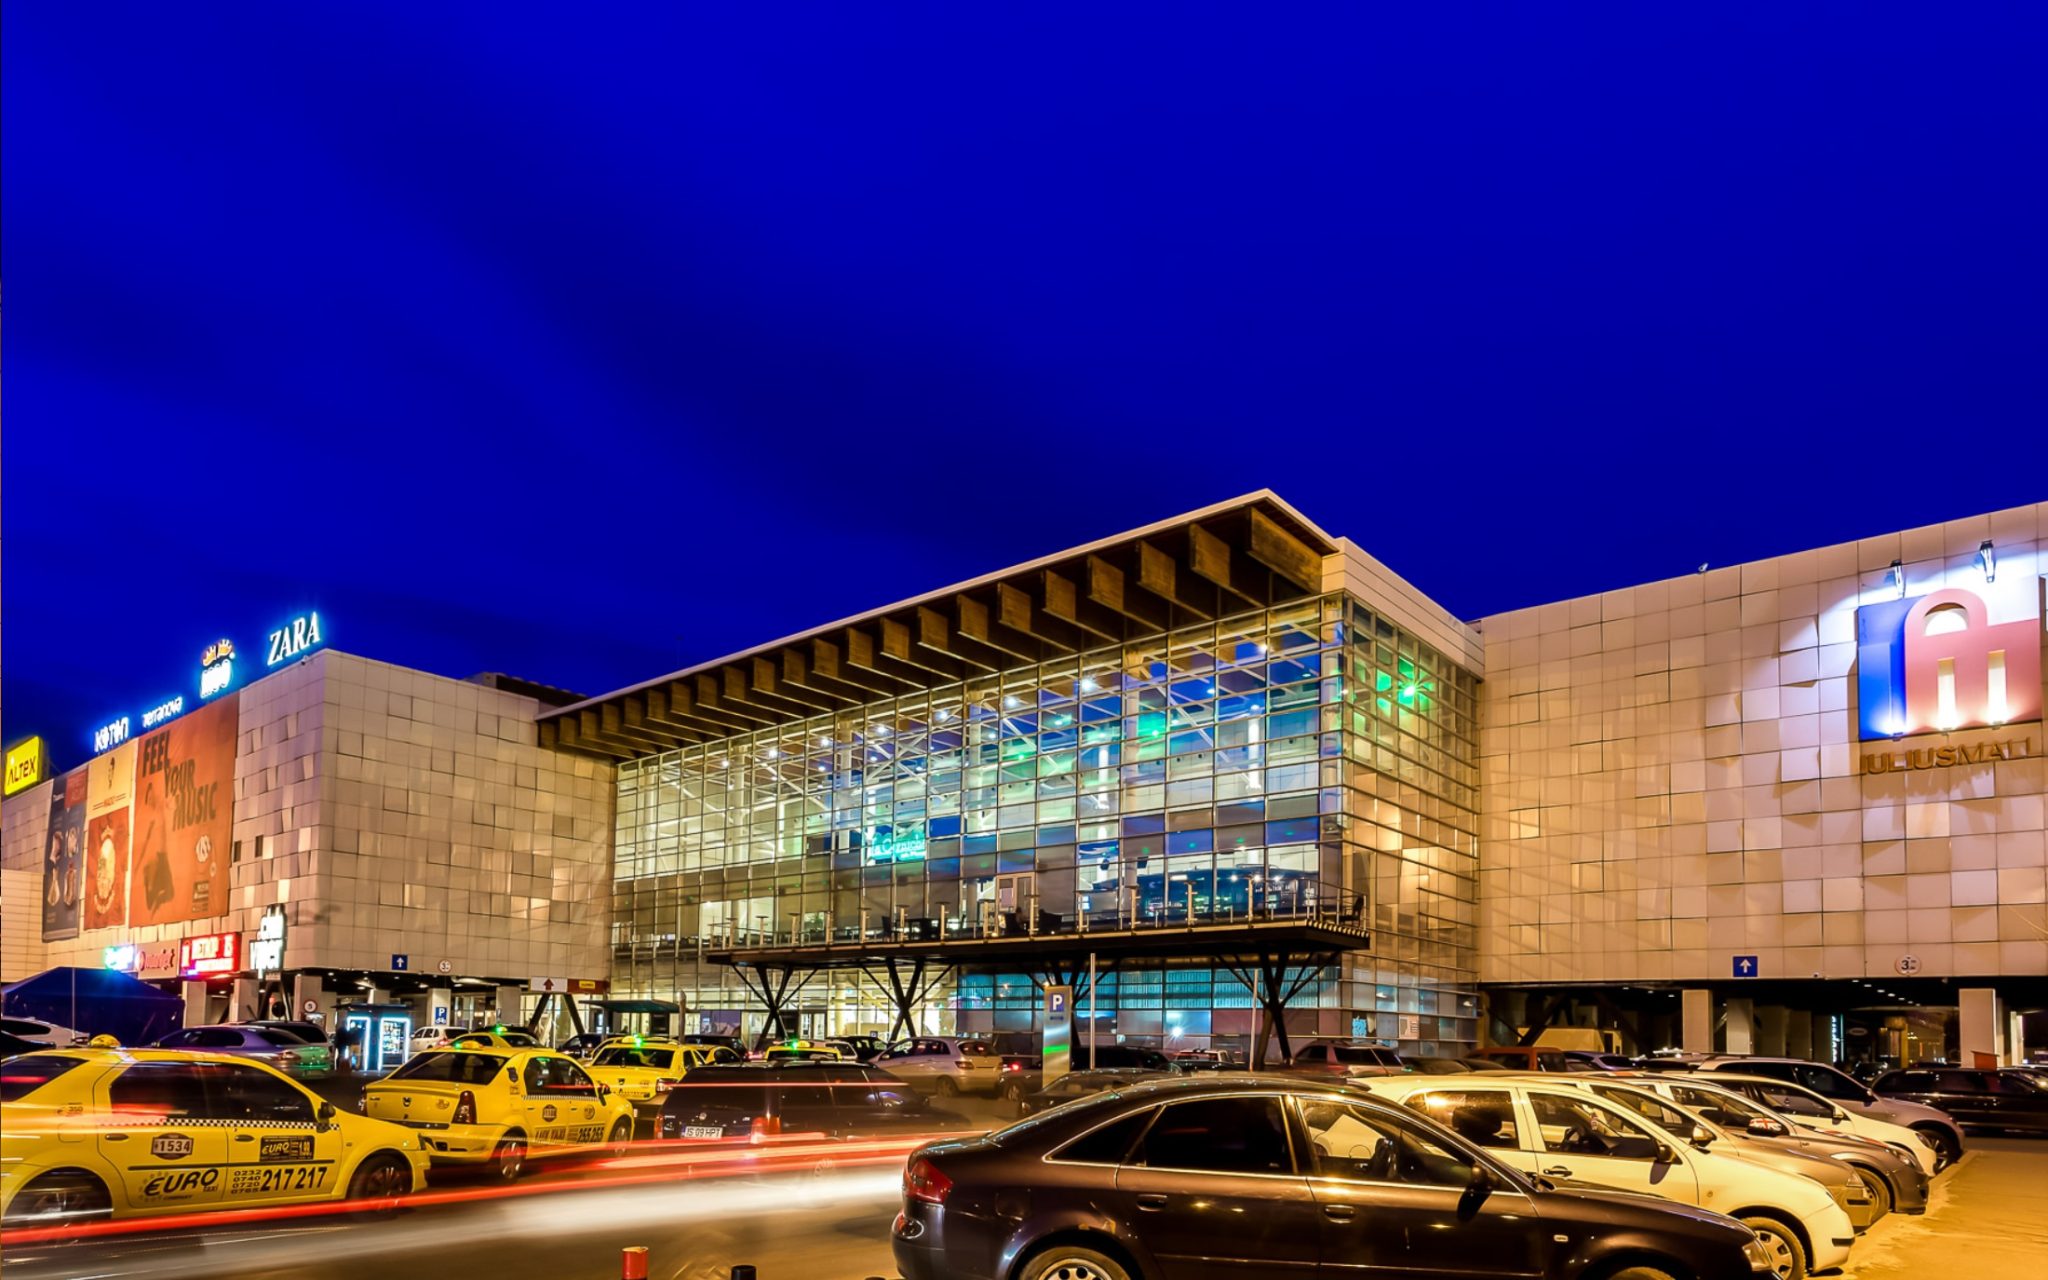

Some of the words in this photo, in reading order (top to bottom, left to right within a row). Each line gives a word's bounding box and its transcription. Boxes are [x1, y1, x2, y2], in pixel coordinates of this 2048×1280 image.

[267, 611, 321, 666] ZARA
[7, 755, 37, 785] ALTEX
[142, 730, 170, 778] FEEL
[164, 758, 195, 798] YOUR
[172, 780, 218, 832] MUSIC
[1052, 994, 1063, 1011] P
[160, 1140, 191, 1152] 1534
